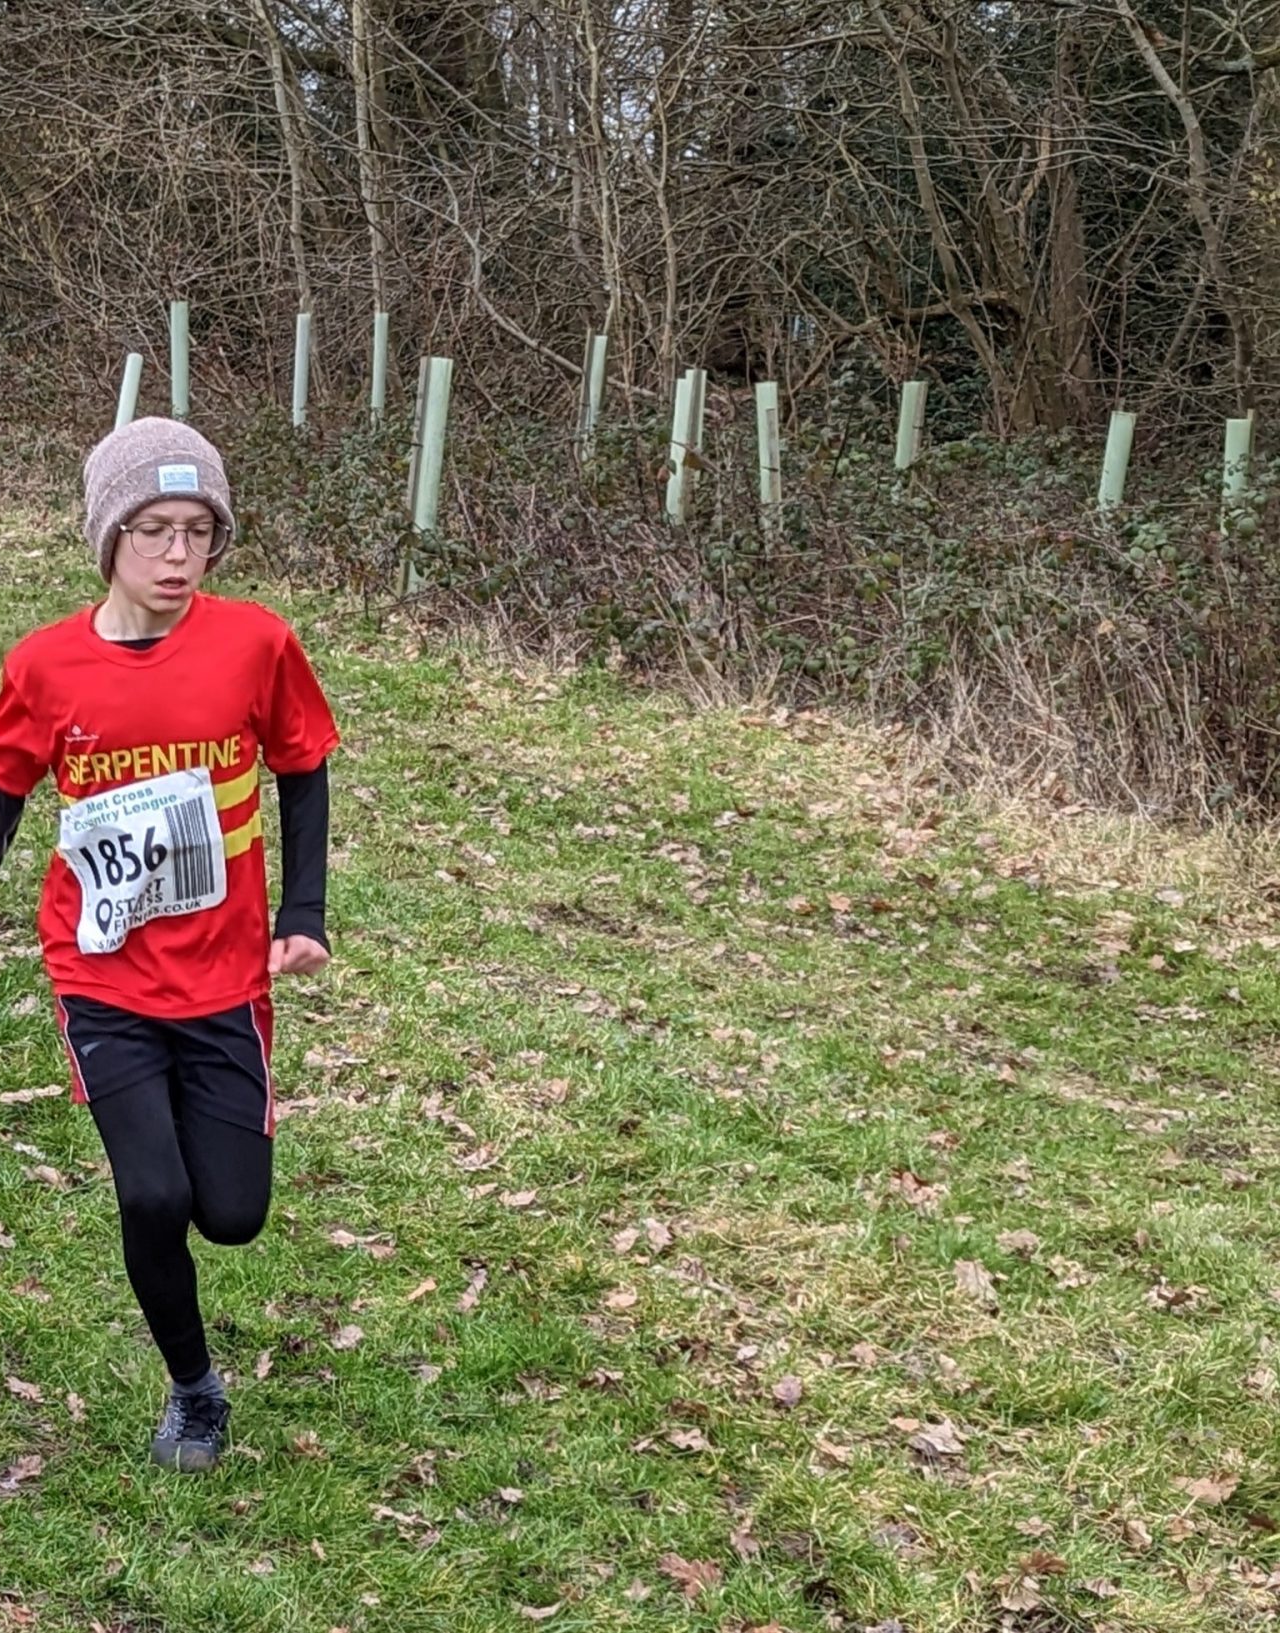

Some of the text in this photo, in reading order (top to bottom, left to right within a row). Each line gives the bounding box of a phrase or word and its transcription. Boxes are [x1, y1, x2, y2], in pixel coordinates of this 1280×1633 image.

[65, 734, 241, 785] SERPENTINE
[73, 794, 177, 832] Country League
[86, 787, 154, 815] Met Cross
[78, 825, 168, 890] 1856
